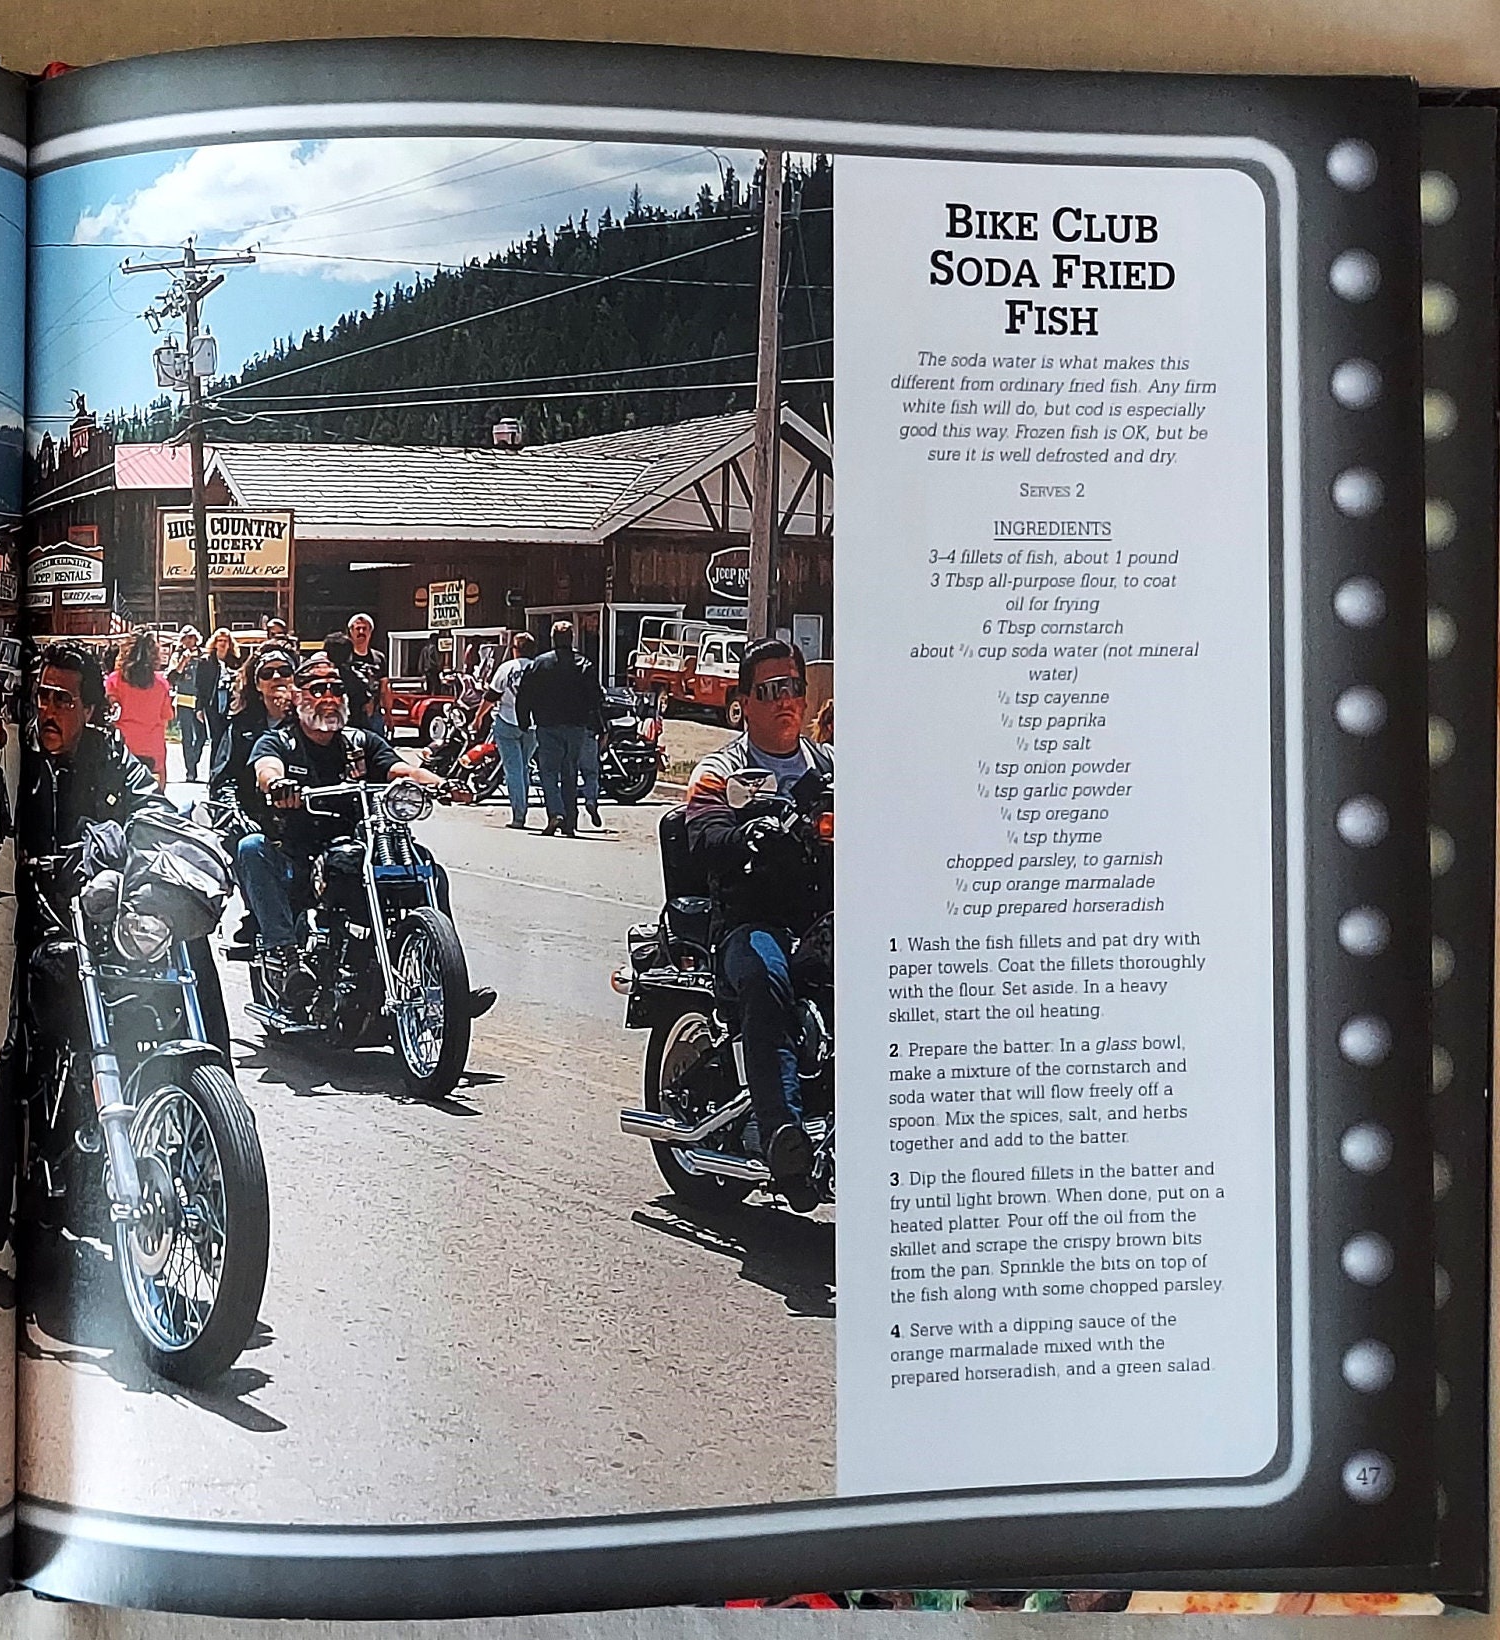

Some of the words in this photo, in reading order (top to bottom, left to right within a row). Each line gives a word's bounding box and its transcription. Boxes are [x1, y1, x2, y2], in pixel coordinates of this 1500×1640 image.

[946, 203, 1038, 241] BIKE
[1053, 207, 1158, 244] CLUB
[930, 249, 1040, 288] SODA
[1052, 254, 1175, 290] FRIED
[1005, 299, 1098, 336] FISH
[918, 350, 947, 367] The
[951, 352, 987, 367] soda
[992, 356, 1037, 369] water
[1041, 357, 1054, 369] is
[1059, 354, 1098, 370] what
[1103, 355, 1155, 370] makes
[1160, 356, 1190, 371] this
[890, 374, 955, 391] different
[960, 375, 994, 391] from
[999, 377, 1065, 395] ordinary
[1068, 378, 1105, 393] fried
[1147, 379, 1180, 397] Any
[1184, 379, 1217, 394] firm
[902, 398, 946, 414] white
[950, 399, 978, 414] fish
[983, 400, 1011, 416] will
[1044, 401, 1071, 416] but
[1075, 402, 1104, 417] cod
[1109, 406, 1122, 417] is
[1126, 402, 1206, 420] especially
[1020, 483, 1070, 498] SERVES
[1076, 482, 1084, 498] 2
[167, 519, 197, 540] HIG
[210, 517, 288, 540] COUNTRY
[994, 520, 1111, 536] INGREDIENTS
[188, 538, 265, 551] GOCERY
[208, 552, 246, 565] DELI
[54, 570, 93, 582] RENTALS
[166, 565, 181, 576] ICE
[232, 565, 258, 576] MILK
[264, 565, 286, 576] POP
[930, 572, 940, 587] 3
[945, 572, 984, 591] Tbsp
[988, 572, 1076, 591] all-purpose
[1124, 575, 1139, 588] to
[1143, 575, 1176, 588] coat
[982, 619, 992, 634] 6
[997, 619, 1036, 637] Tbsp
[1040, 619, 1124, 634] cornstarch
[946, 853, 1014, 871] chopped
[1083, 854, 1099, 867] to
[1103, 850, 1163, 870] garnish
[889, 963, 932, 979] paper
[998, 957, 1035, 972] Coat
[1040, 956, 1065, 971] the
[1071, 955, 1113, 971] fillets
[1120, 954, 1205, 972] thoroughly
[890, 1135, 954, 1155] together
[960, 1133, 988, 1148] and
[995, 1131, 1023, 1147] add
[1029, 1133, 1043, 1146] to
[1050, 1130, 1074, 1146] the
[890, 1240, 936, 1257] skillet
[942, 1238, 970, 1255] and
[976, 1239, 1027, 1254] scrape
[1033, 1235, 1057, 1250] the
[1064, 1236, 1110, 1252] crispy
[1117, 1232, 1166, 1247] brown
[1173, 1231, 1201, 1246] bits
[891, 1348, 944, 1364] orange
[950, 1339, 1038, 1359] marmalade
[1044, 1337, 1091, 1353] mixed
[1097, 1336, 1133, 1352] with
[1140, 1335, 1164, 1350] the
[1356, 1466, 1381, 1485] 47
